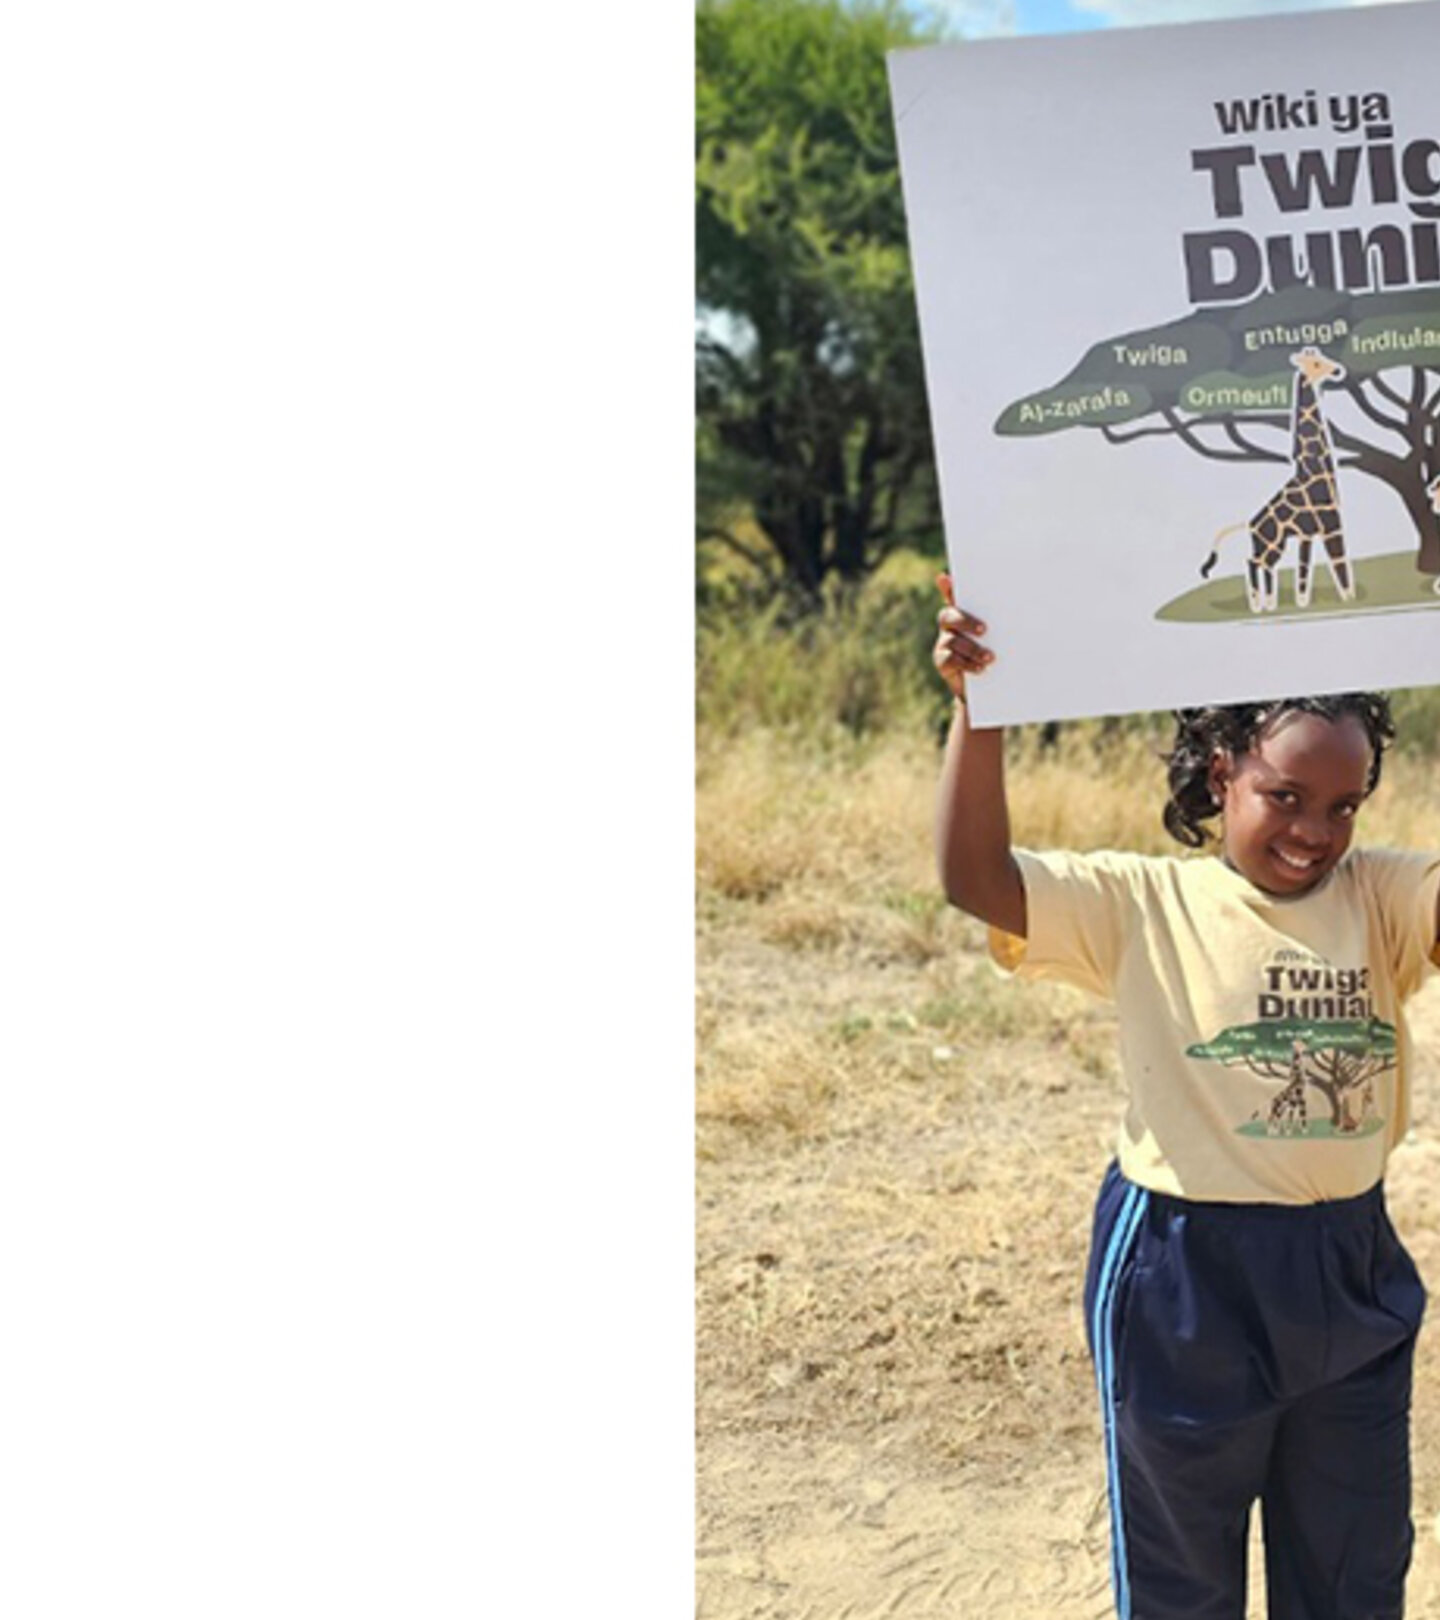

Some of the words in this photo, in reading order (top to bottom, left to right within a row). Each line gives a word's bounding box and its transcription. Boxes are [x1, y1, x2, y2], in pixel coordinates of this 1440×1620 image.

[1213, 89, 1319, 134] Wiki
[1329, 92, 1391, 133] ya
[1245, 318, 1348, 351] Entugga
[1113, 344, 1188, 367] Twiga
